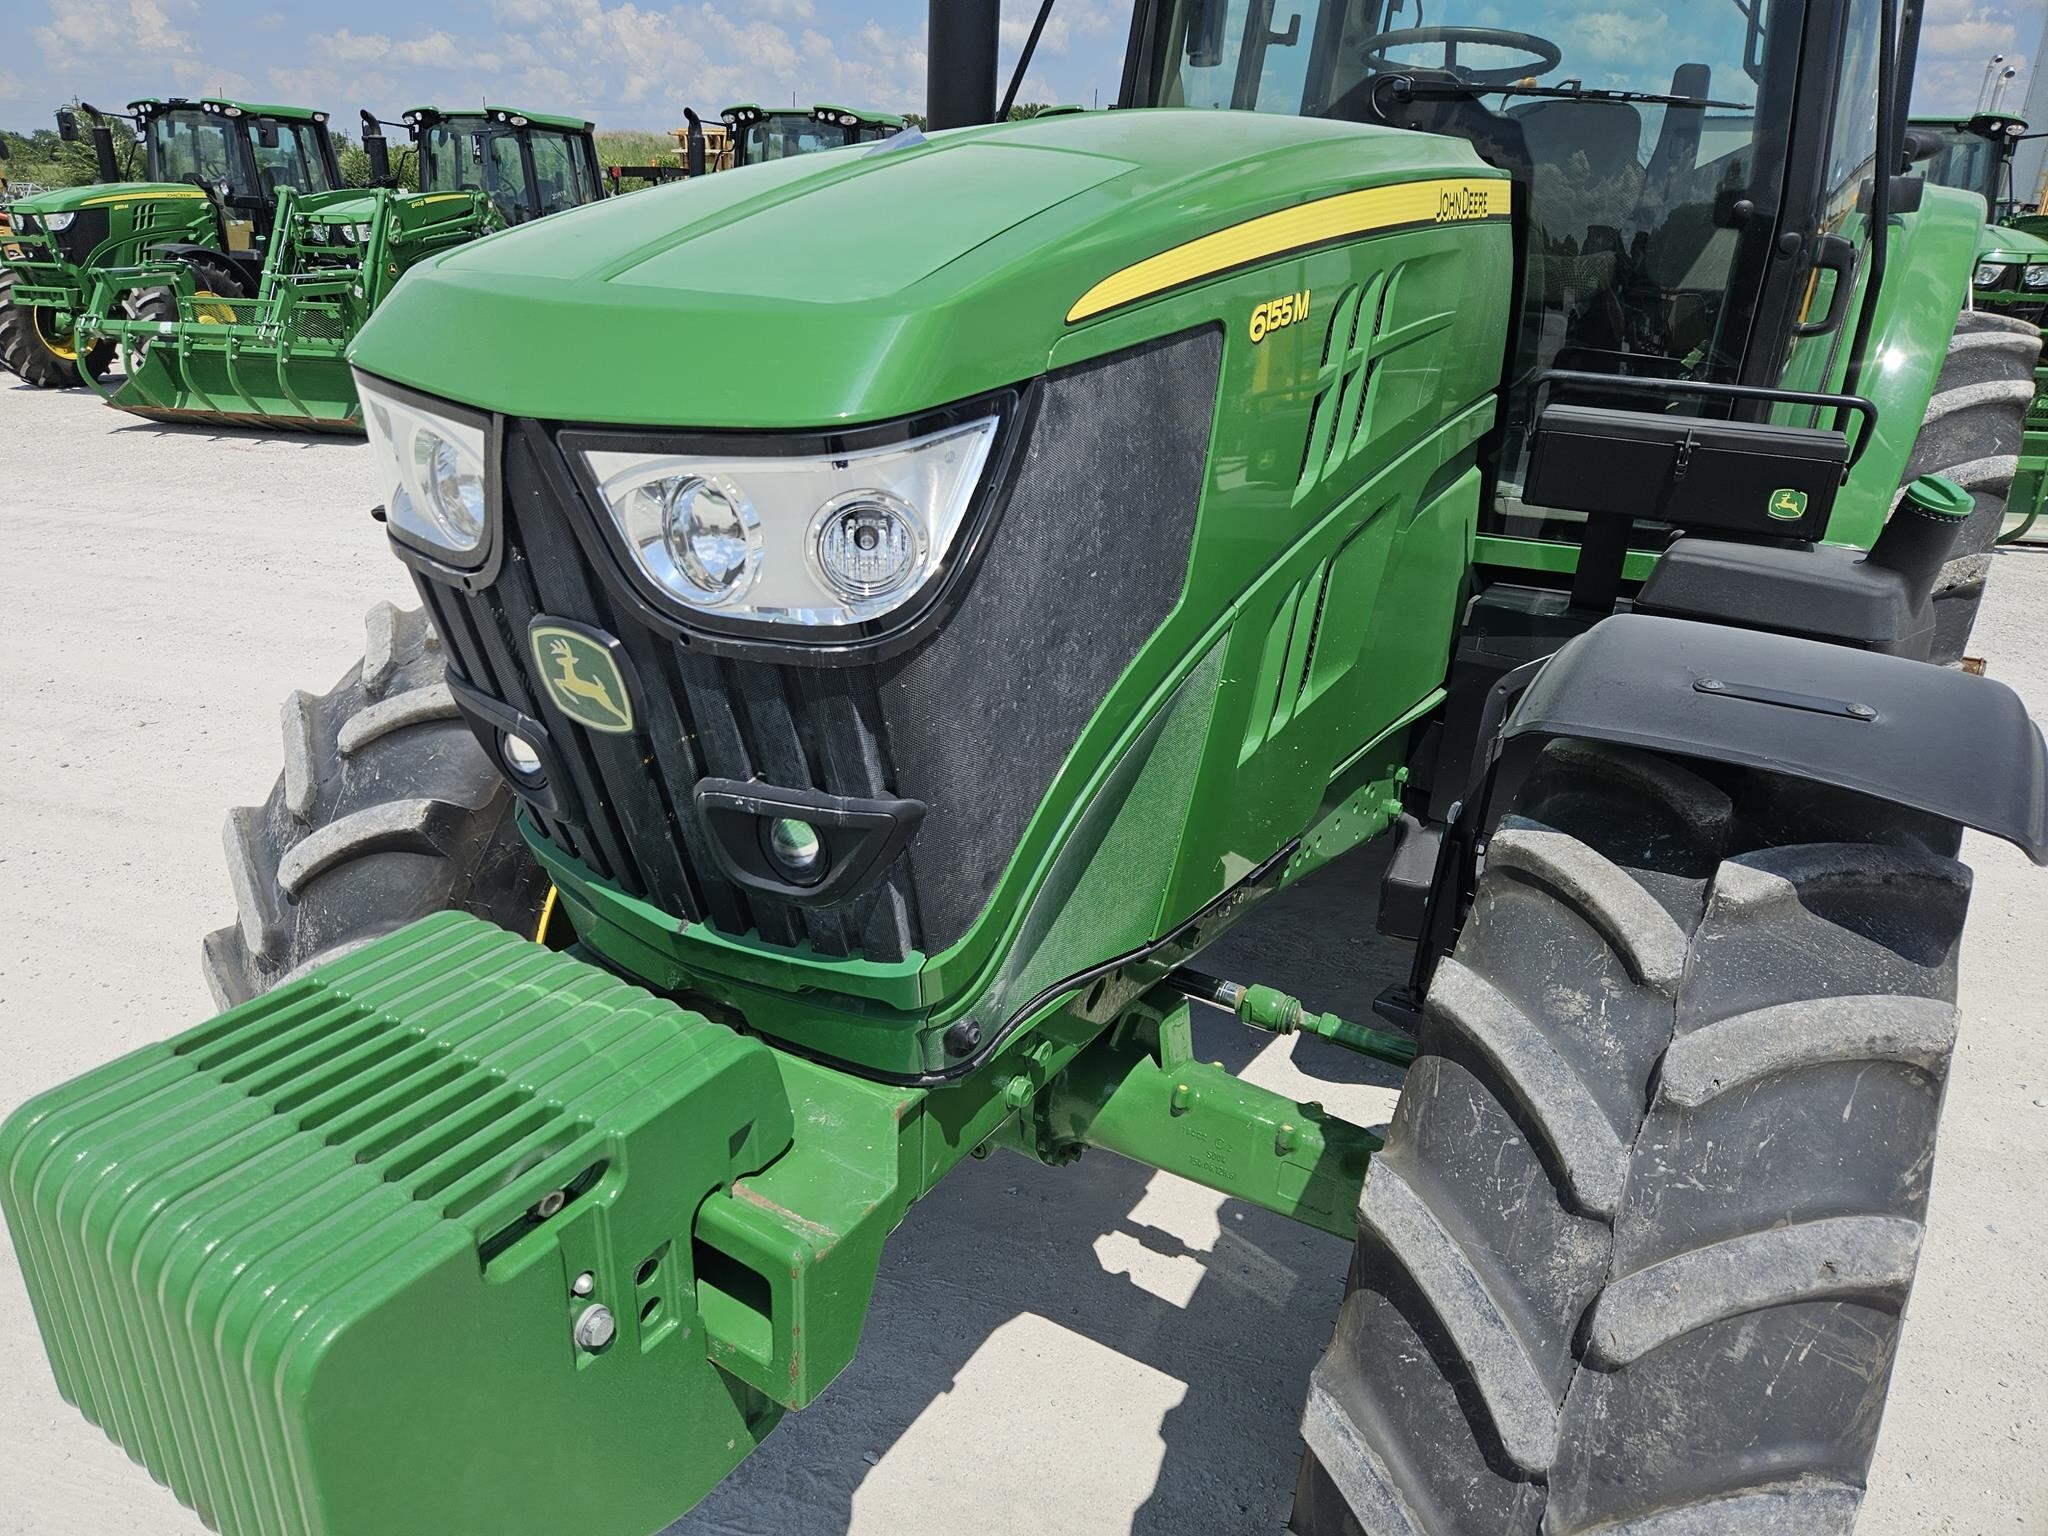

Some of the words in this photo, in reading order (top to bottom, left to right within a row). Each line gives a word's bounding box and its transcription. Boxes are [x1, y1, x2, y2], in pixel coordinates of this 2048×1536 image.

[1436, 187, 1462, 219] JOHN
[1462, 186, 1489, 217] DEERE
[1249, 288, 1311, 344] 6155M
